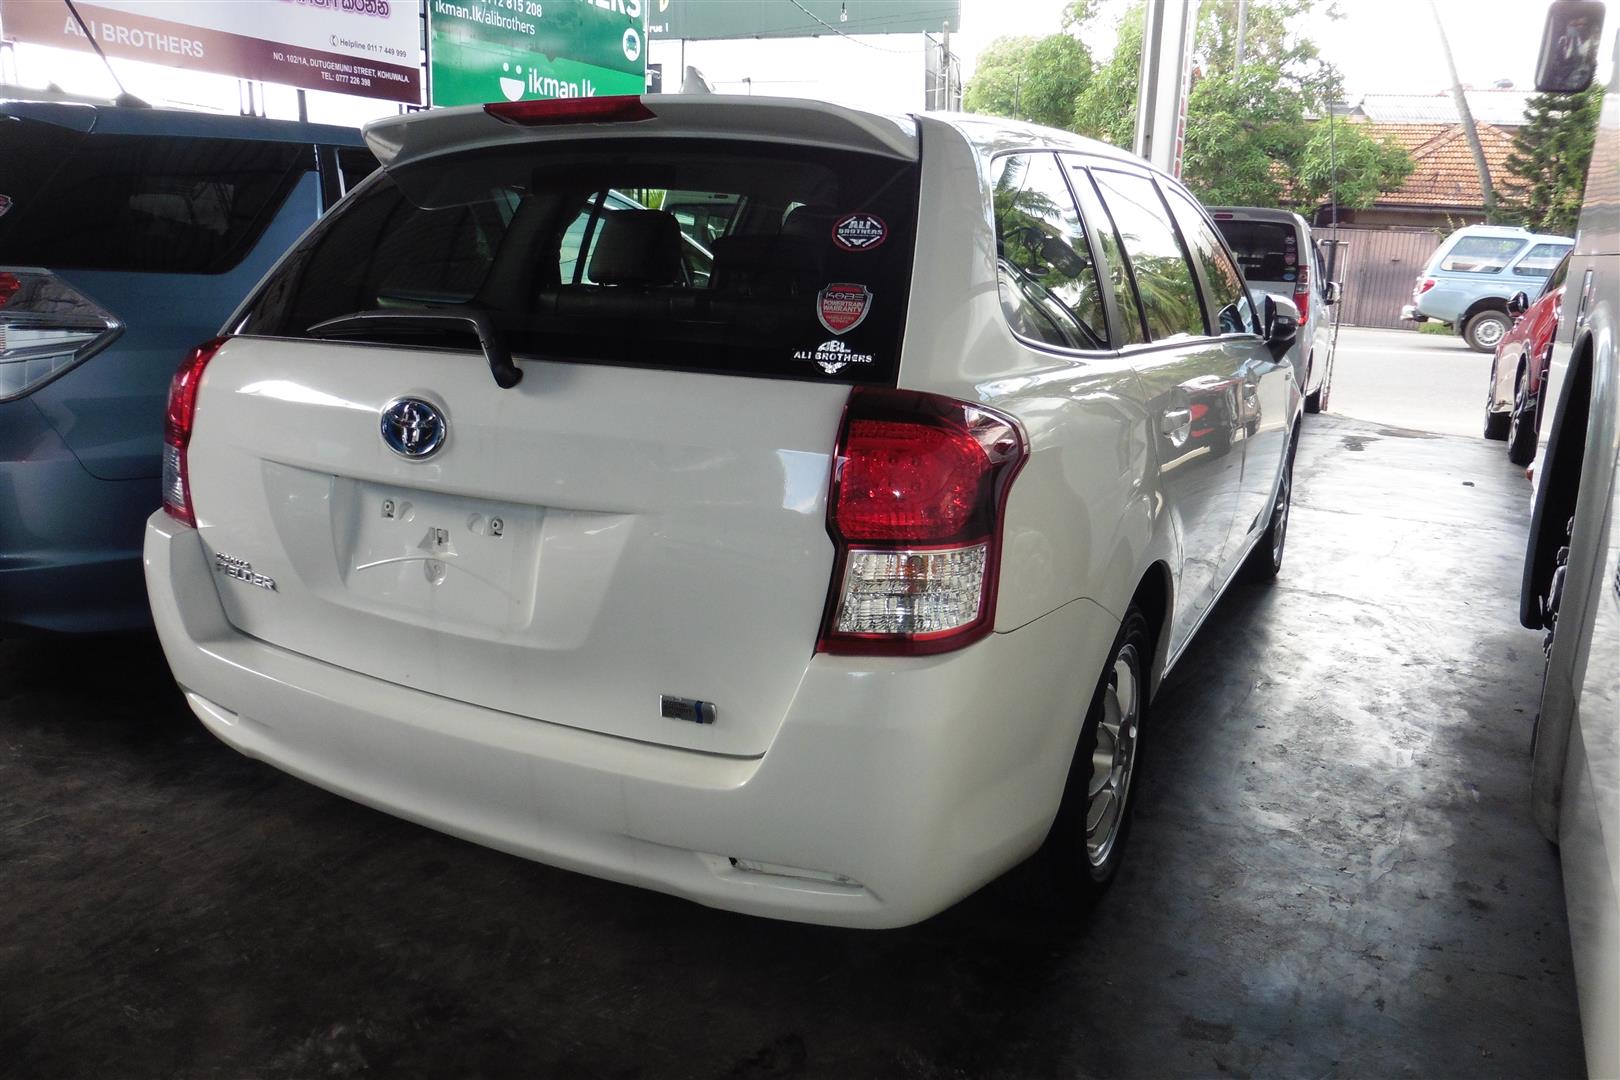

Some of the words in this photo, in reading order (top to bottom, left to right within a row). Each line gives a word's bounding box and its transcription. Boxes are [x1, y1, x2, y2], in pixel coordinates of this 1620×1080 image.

[435, 0, 535, 35] ikman.lk/alibrothers
[506, 0, 524, 12] 815
[526, 1, 542, 17] 208
[102, 23, 204, 58] BROTHERS
[340, 38, 366, 50] Helpline
[367, 43, 378, 52] 011
[384, 47, 395, 56] 449
[396, 49, 407, 58] 999
[273, 52, 285, 61] NO.
[310, 58, 352, 73] DUTUGEMUNU
[353, 65, 376, 77] STREET,
[321, 71, 335, 81] TEL:
[335, 74, 349, 83] 0777
[528, 67, 596, 98] ikmanlk
[849, 220, 871, 229] ALI
[793, 351, 812, 360] ALI
[815, 352, 872, 363] BROTHERS
